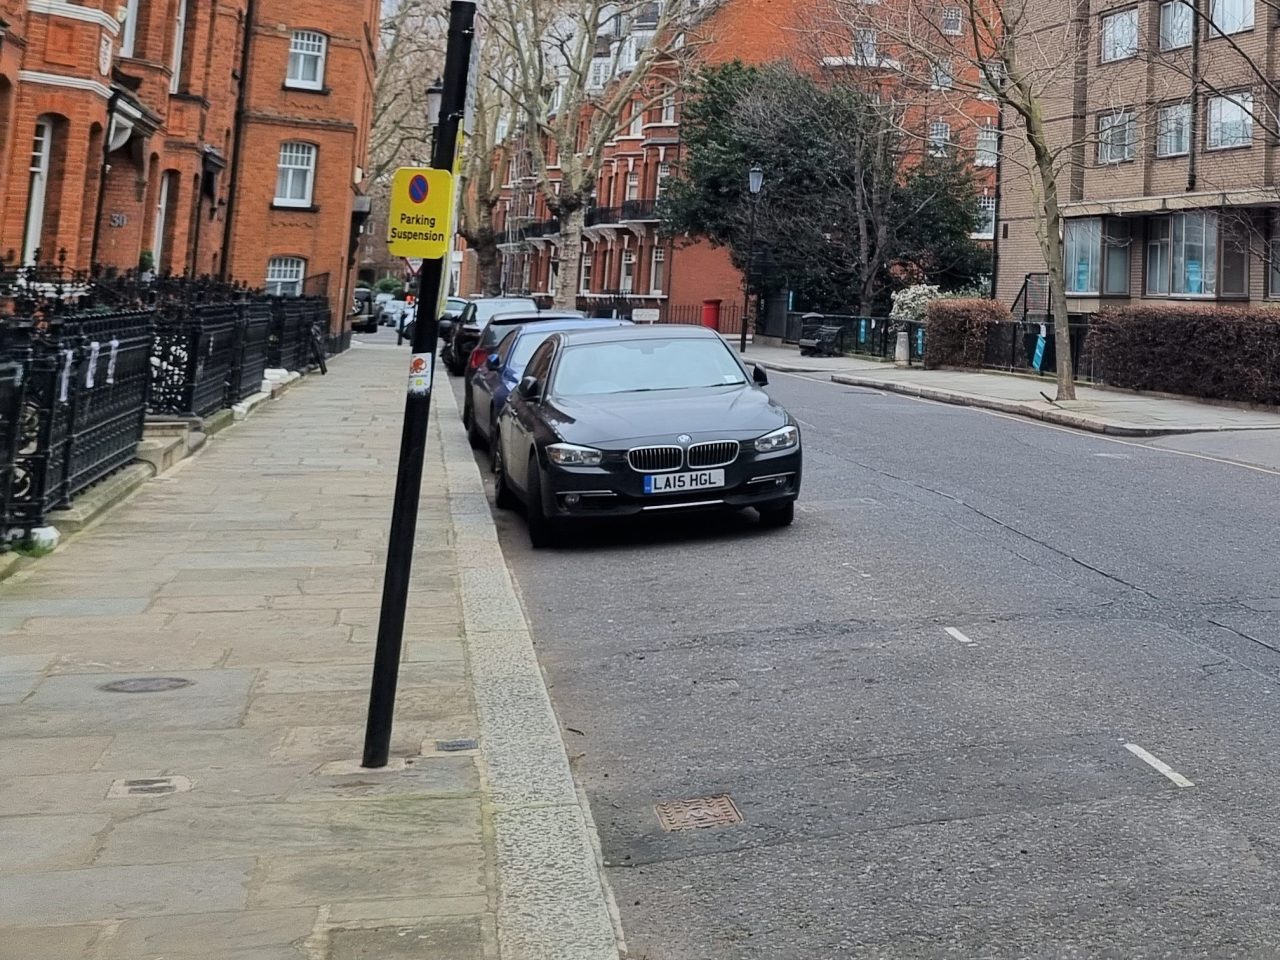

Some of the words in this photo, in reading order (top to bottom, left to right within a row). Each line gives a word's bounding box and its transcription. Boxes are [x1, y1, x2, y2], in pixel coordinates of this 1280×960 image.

[400, 213, 436, 228] Parking
[391, 227, 444, 241] Suspension
[653, 475, 686, 490] LA15
[689, 472, 716, 486] HGL
